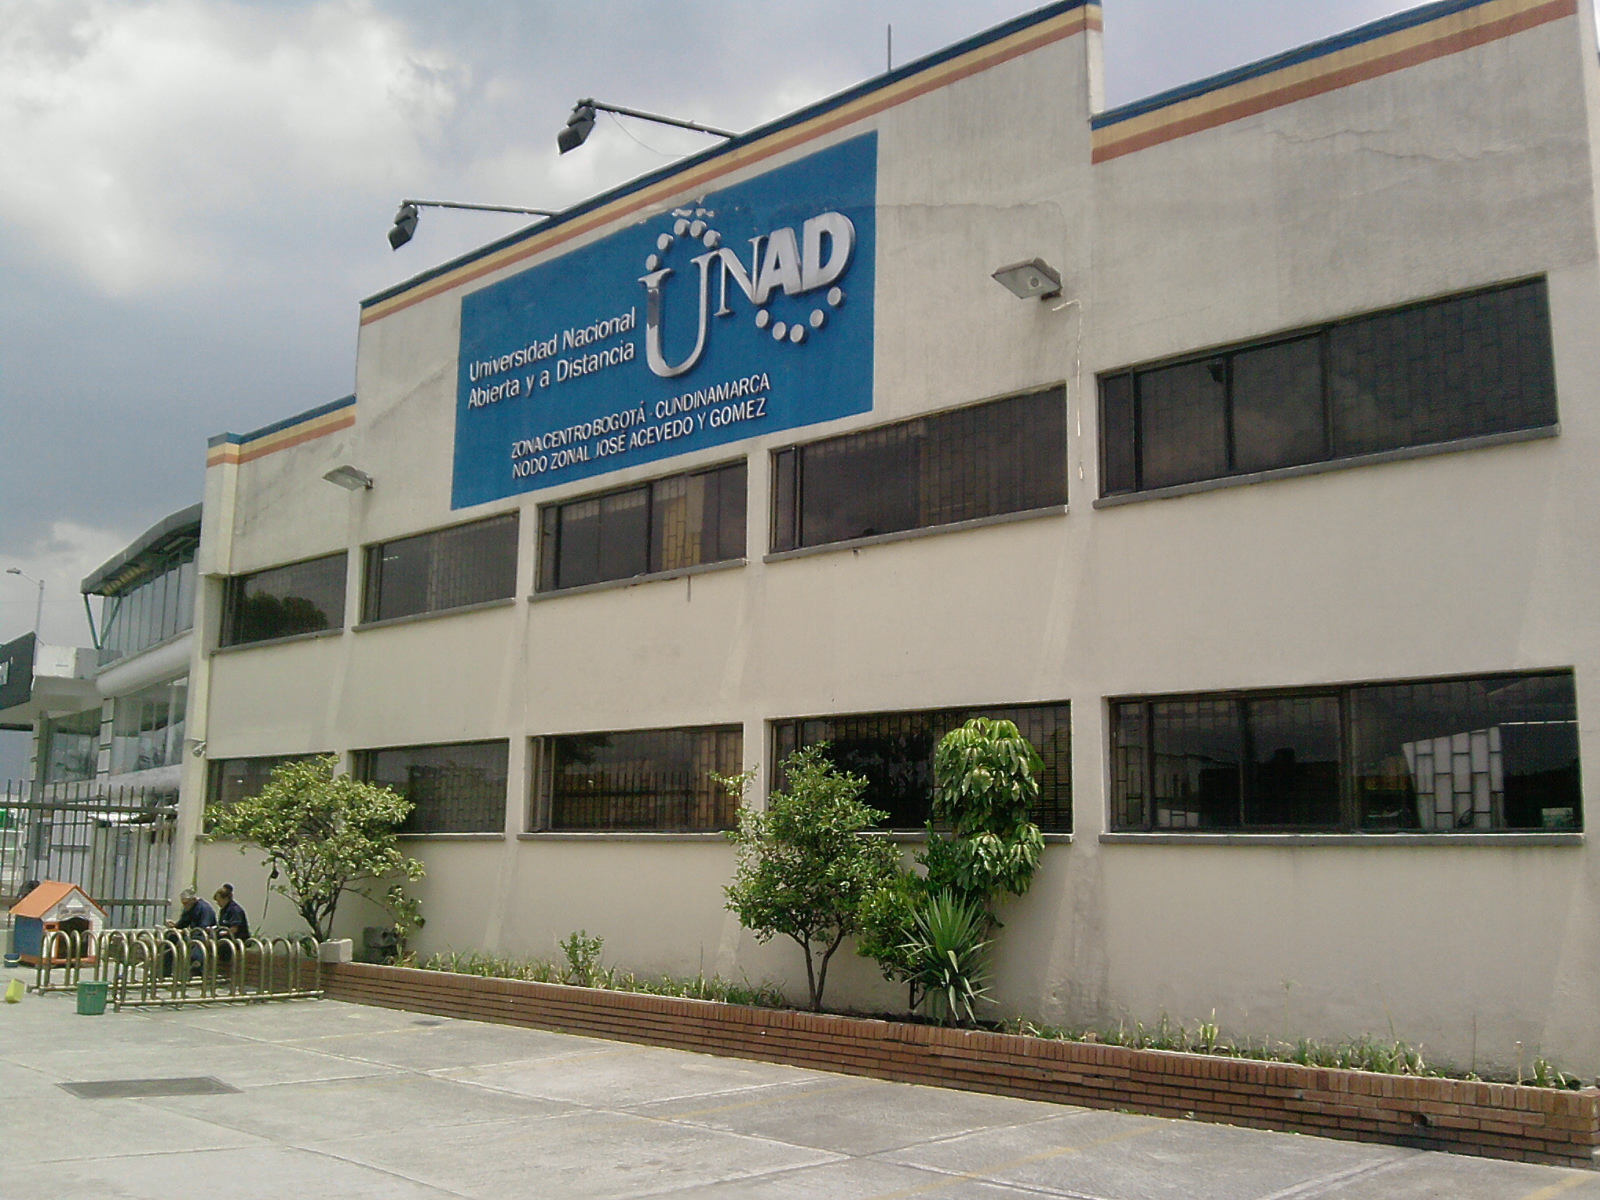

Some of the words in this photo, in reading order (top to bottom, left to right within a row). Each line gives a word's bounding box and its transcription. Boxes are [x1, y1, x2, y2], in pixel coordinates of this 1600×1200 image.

[638, 211, 857, 378] UNAD
[468, 379, 521, 409] Abierta
[525, 374, 535, 397] y
[539, 369, 550, 388] a
[556, 340, 635, 383] Distancia
[469, 333, 558, 383] Universidad
[562, 306, 637, 351] Nacional
[511, 436, 543, 459] ZONA
[543, 423, 592, 450] CENTRO
[592, 401, 646, 436] BOGOTÁ
[655, 372, 770, 419] CUNDINAMARCA
[512, 455, 549, 479] NODO
[550, 445, 592, 470] ZONAL
[594, 430, 626, 457] JOSÉ
[629, 416, 694, 449] ACEVEDO
[697, 411, 707, 430] Y
[709, 397, 767, 428] GOMEZ
